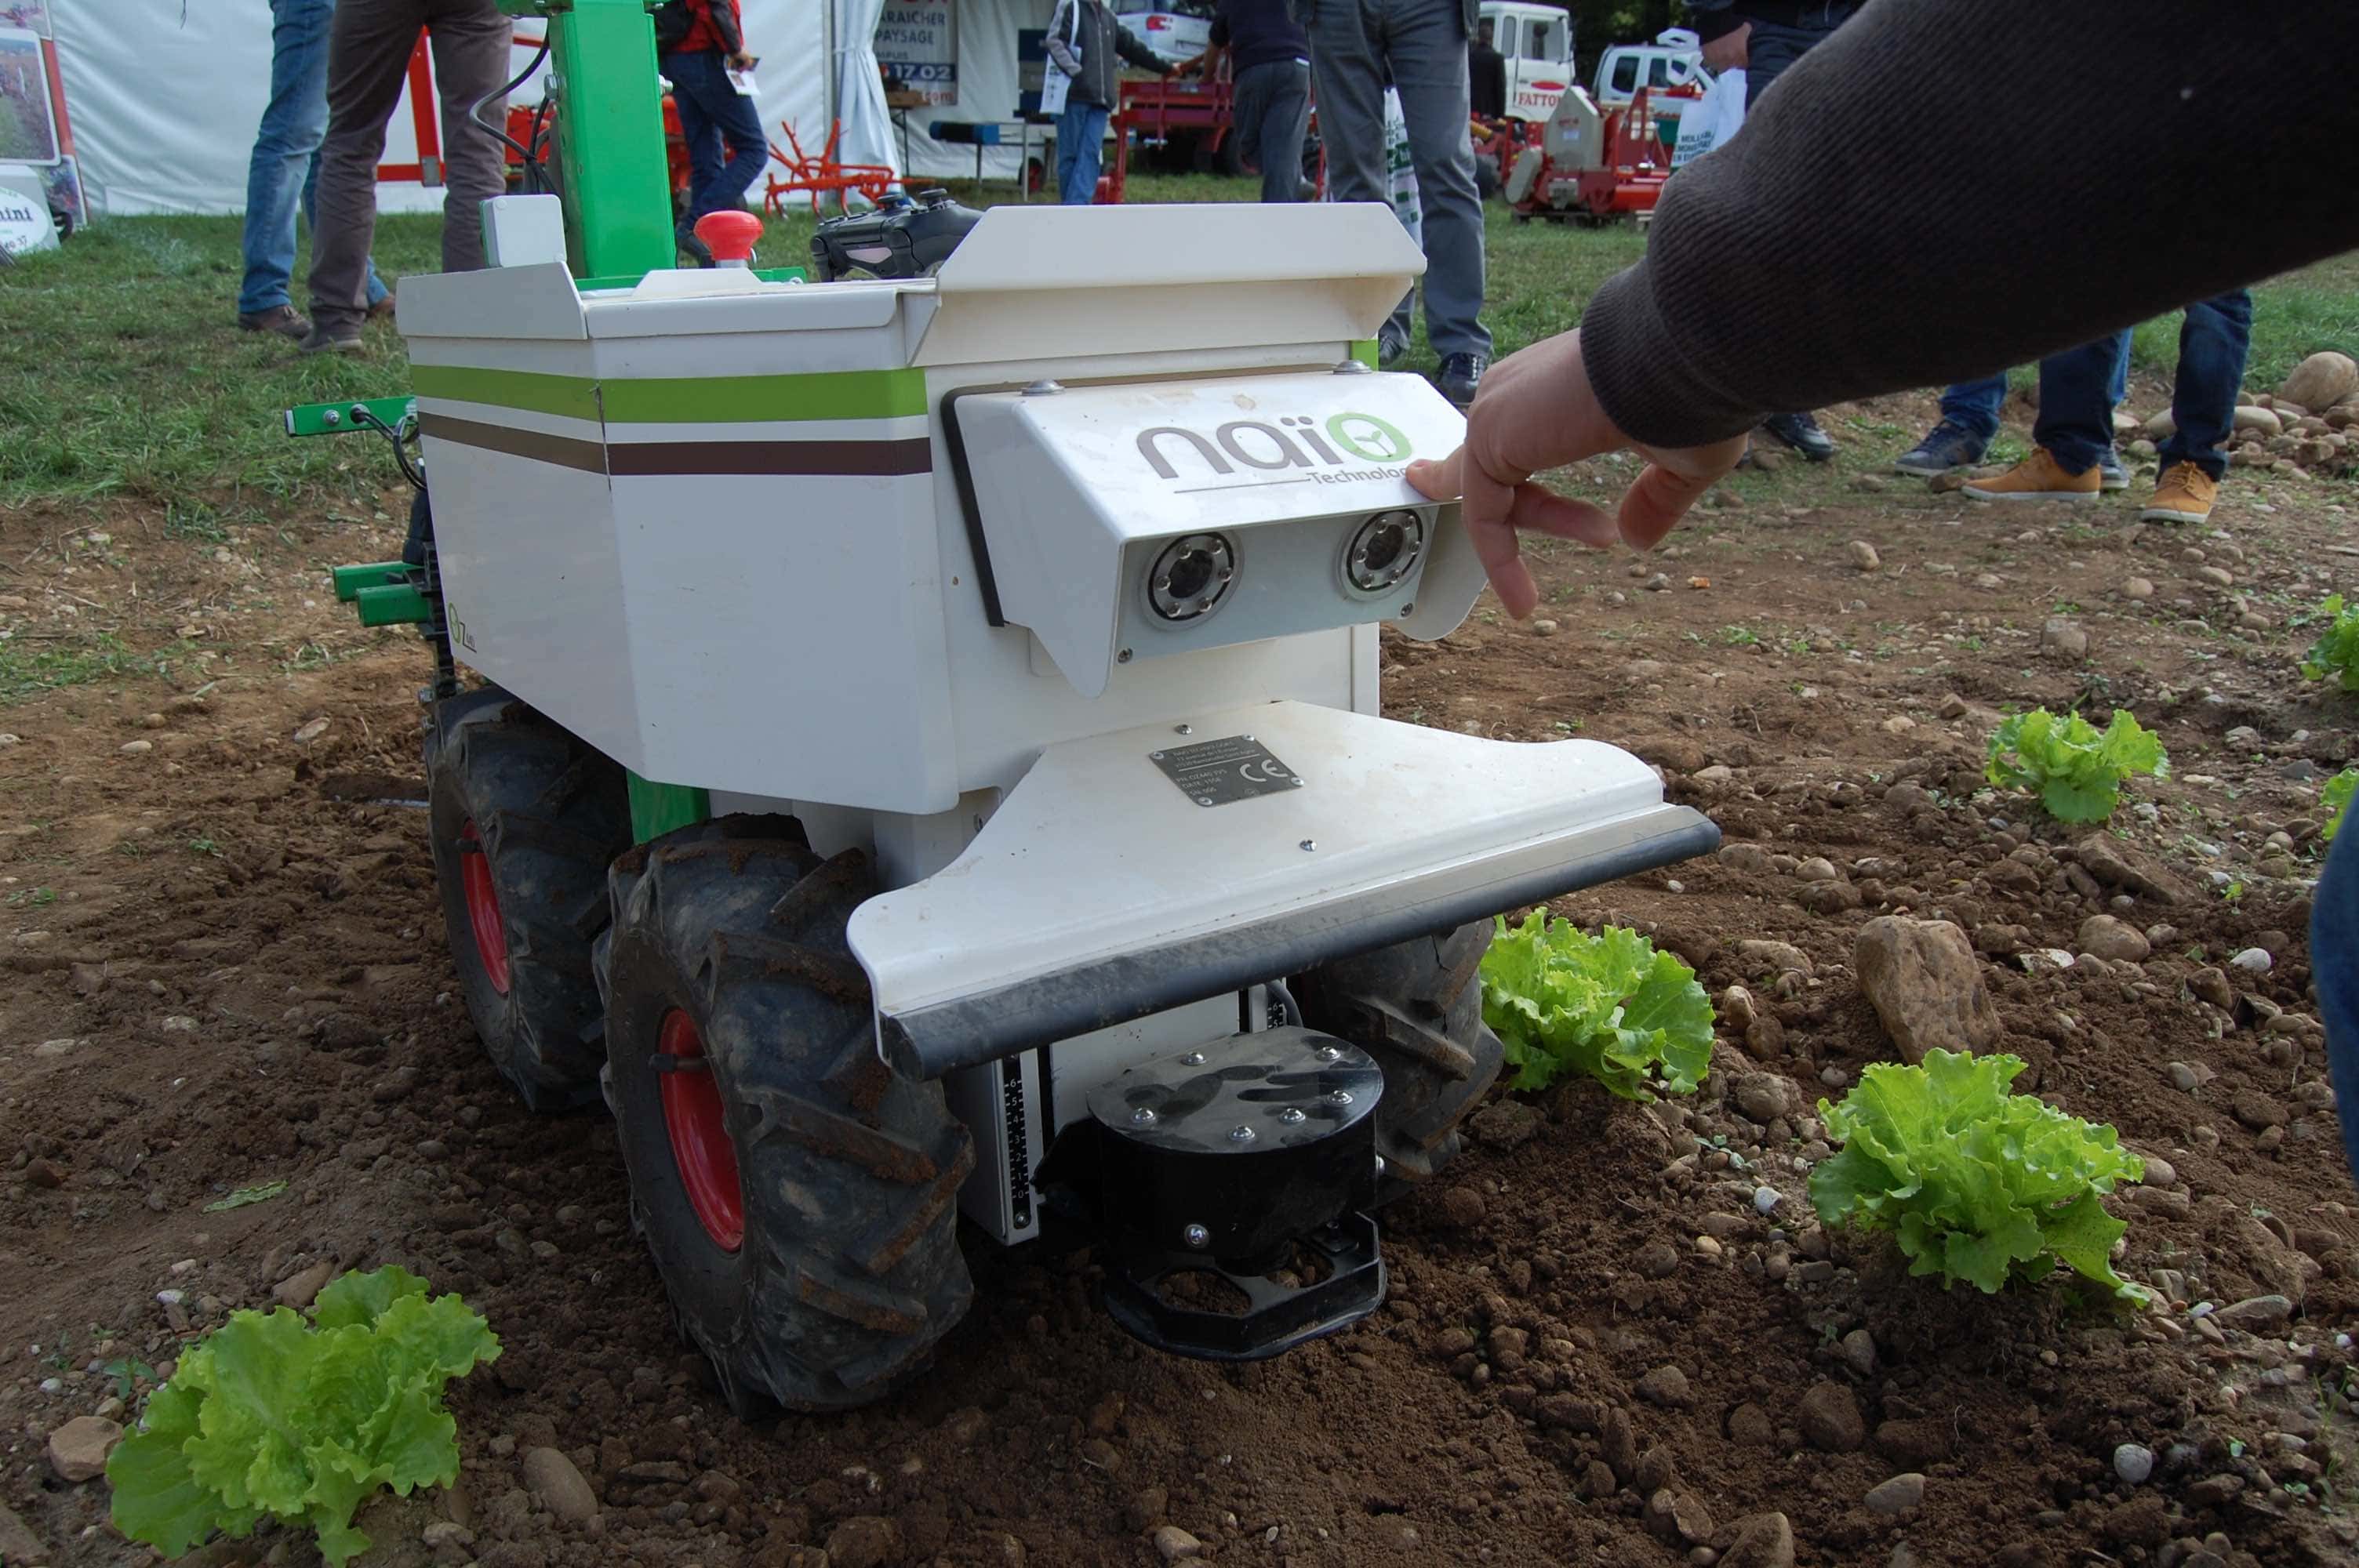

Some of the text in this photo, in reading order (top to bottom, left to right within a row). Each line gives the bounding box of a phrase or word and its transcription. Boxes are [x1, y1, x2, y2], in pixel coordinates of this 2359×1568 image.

[1239, 758, 1289, 782] CE
[1010, 1079, 1017, 1088] 6
[1012, 1098, 1018, 1107] 5
[1012, 1115, 1019, 1124] 4
[1016, 1134, 1021, 1145] 3
[1016, 1152, 1022, 1162] 2
[1018, 1189, 1024, 1200] 0
